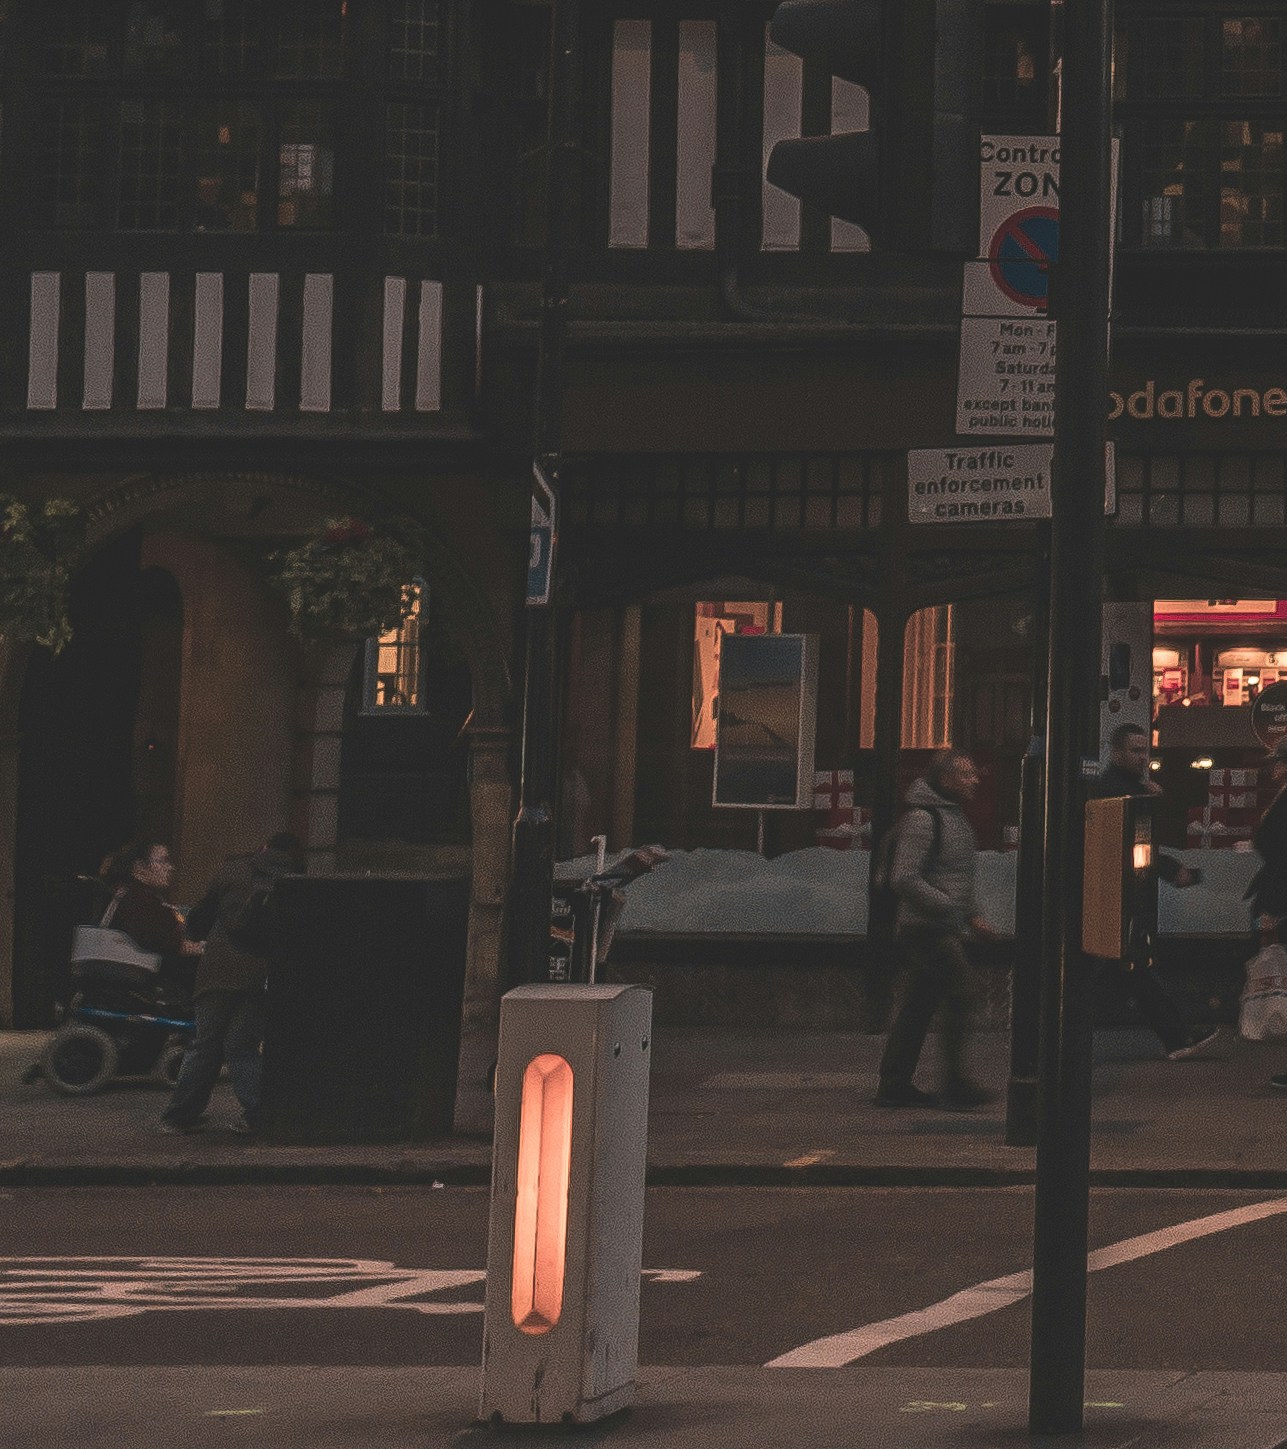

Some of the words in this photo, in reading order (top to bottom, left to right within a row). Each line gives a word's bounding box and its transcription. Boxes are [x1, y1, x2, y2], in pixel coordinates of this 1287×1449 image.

[980, 142, 1061, 163] Contro
[993, 171, 1061, 197] ZON
[1000, 323, 1033, 337] Mon
[995, 361, 1057, 375] Saturda
[964, 399, 1016, 414] except
[1022, 399, 1056, 412] ban
[969, 416, 1016, 429] public
[1023, 416, 1056, 429] holi
[946, 452, 1014, 471] Traffic
[915, 473, 1044, 494] enforcement
[935, 500, 1025, 517] cameras
